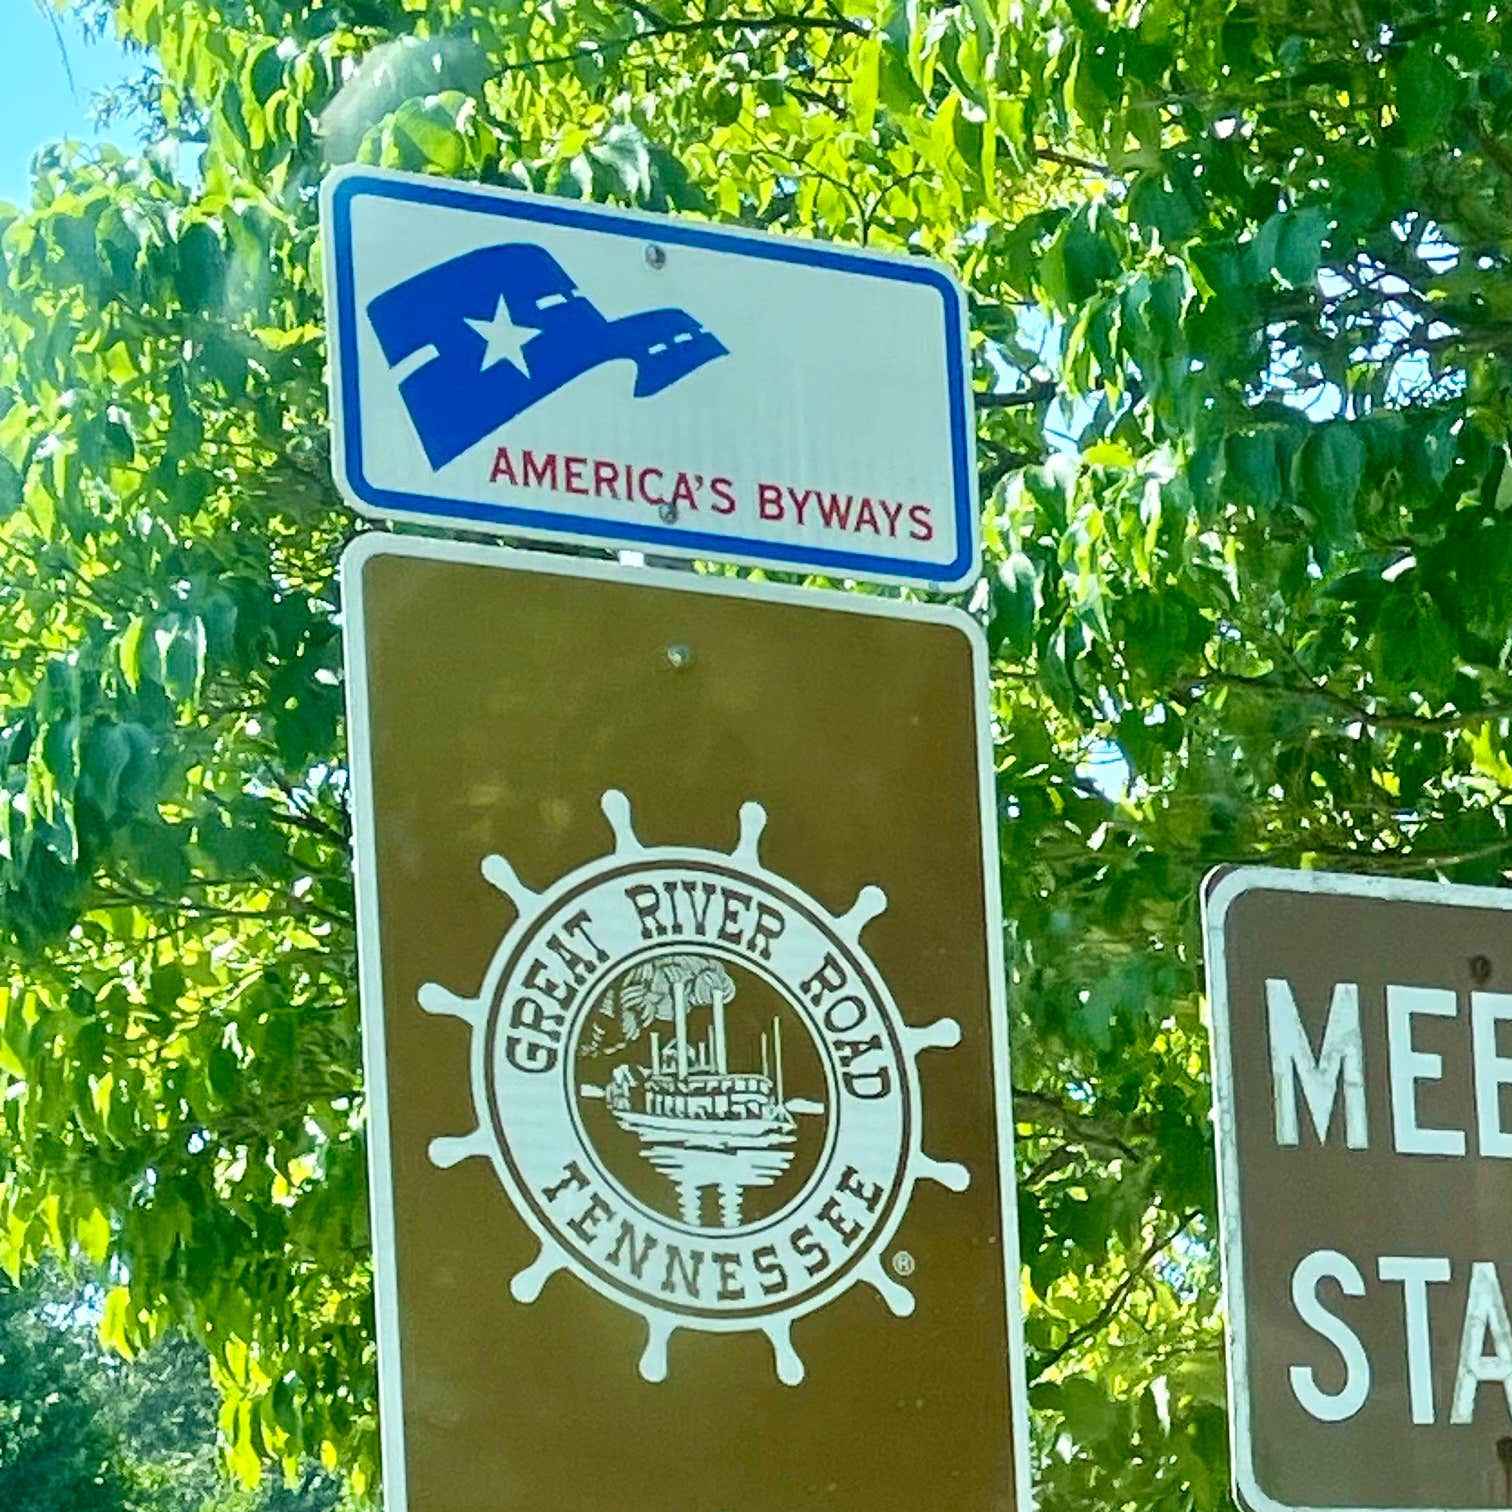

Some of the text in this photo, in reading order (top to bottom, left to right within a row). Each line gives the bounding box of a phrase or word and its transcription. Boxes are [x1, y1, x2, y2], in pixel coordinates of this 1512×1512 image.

[488, 446, 935, 543] AMERICA'S BYWAYS
[504, 879, 893, 1102] GREAT RIVER ROAD
[541, 1160, 886, 1303] TENNESSEE
